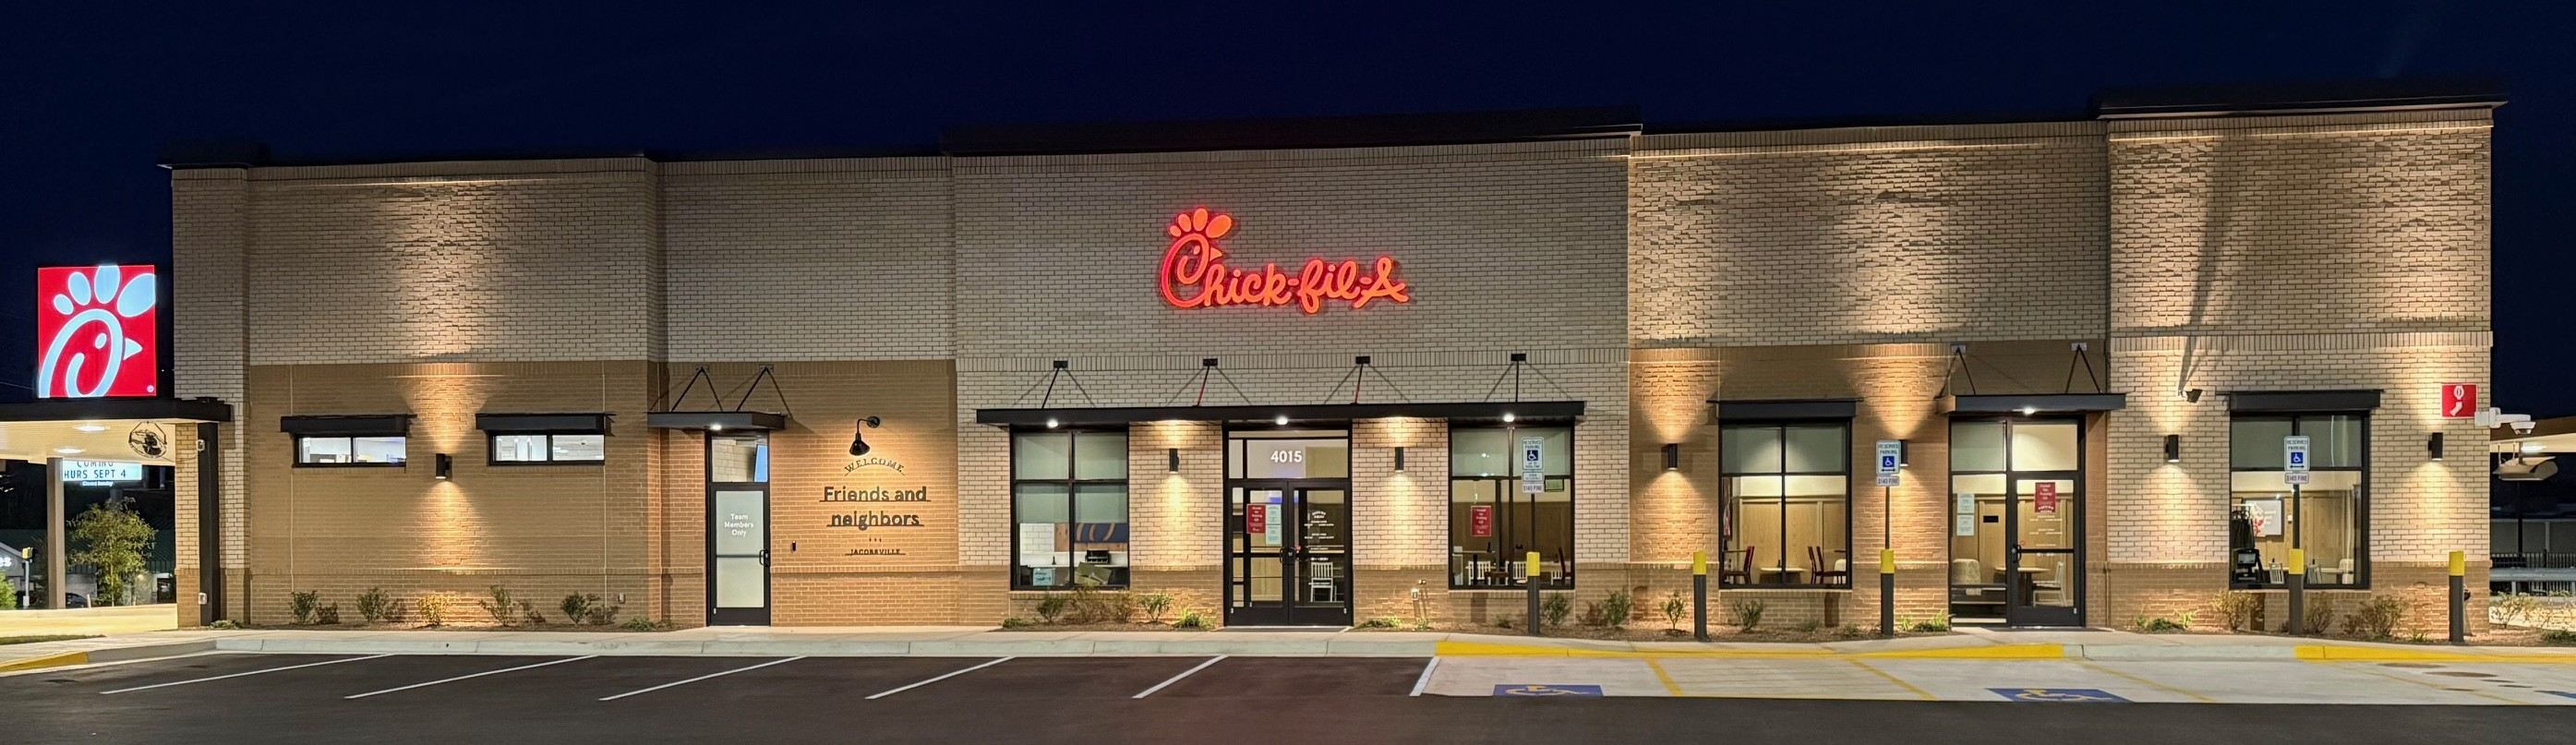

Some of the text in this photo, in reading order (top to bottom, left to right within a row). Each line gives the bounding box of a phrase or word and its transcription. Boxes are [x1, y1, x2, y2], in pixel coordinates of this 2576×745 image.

[1160, 209, 1410, 315] Chick-fil-A
[1270, 450, 1303, 463] 4015
[844, 457, 905, 473] WELCOME
[64, 468, 126, 478] HURS SEPT 4
[824, 486, 927, 501] Friends and
[831, 511, 920, 531] neighbors
[731, 529, 747, 538] Only
